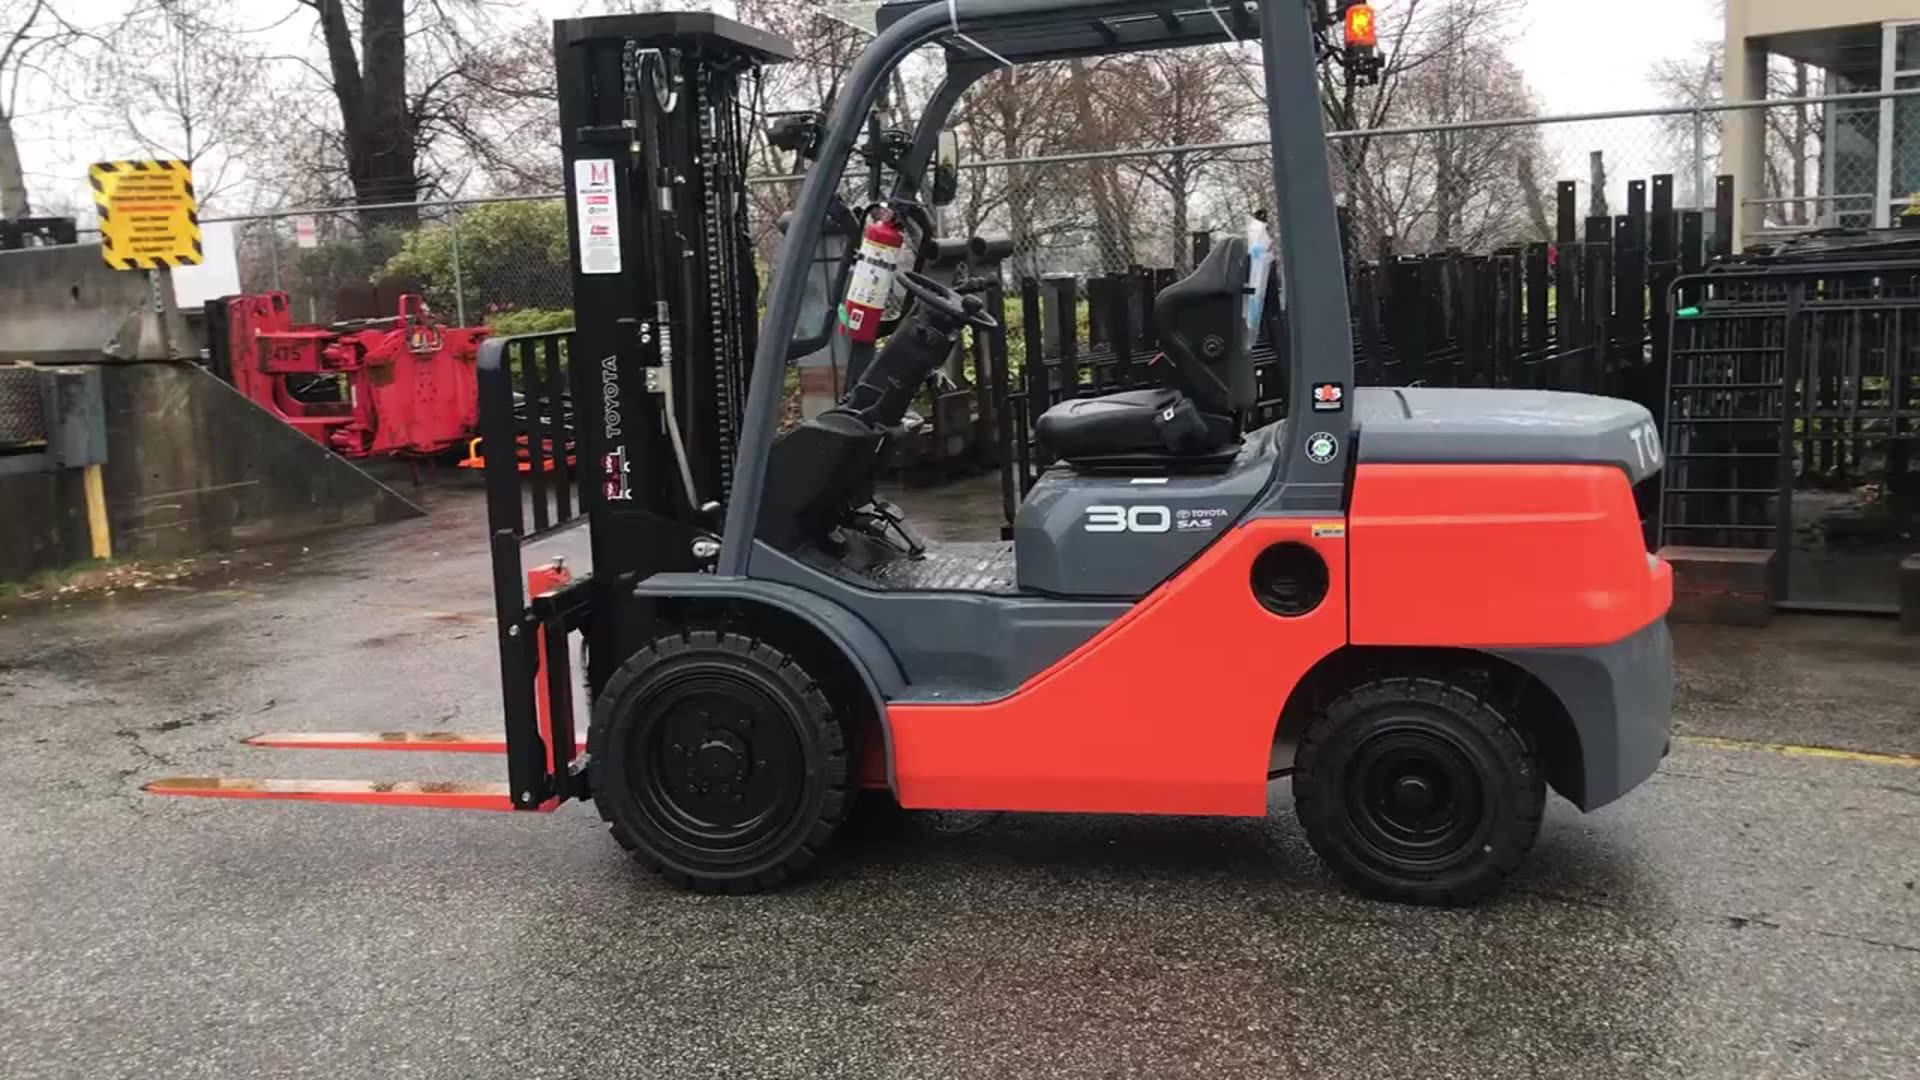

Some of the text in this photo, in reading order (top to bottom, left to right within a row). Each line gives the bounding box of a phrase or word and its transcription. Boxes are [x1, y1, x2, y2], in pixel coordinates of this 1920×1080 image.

[601, 355, 621, 439] TOYOTA
[1629, 423, 1659, 470] TO
[1084, 505, 1171, 533] 30
[1176, 519, 1213, 529] SAS
[1191, 509, 1228, 517] TOYOTA
